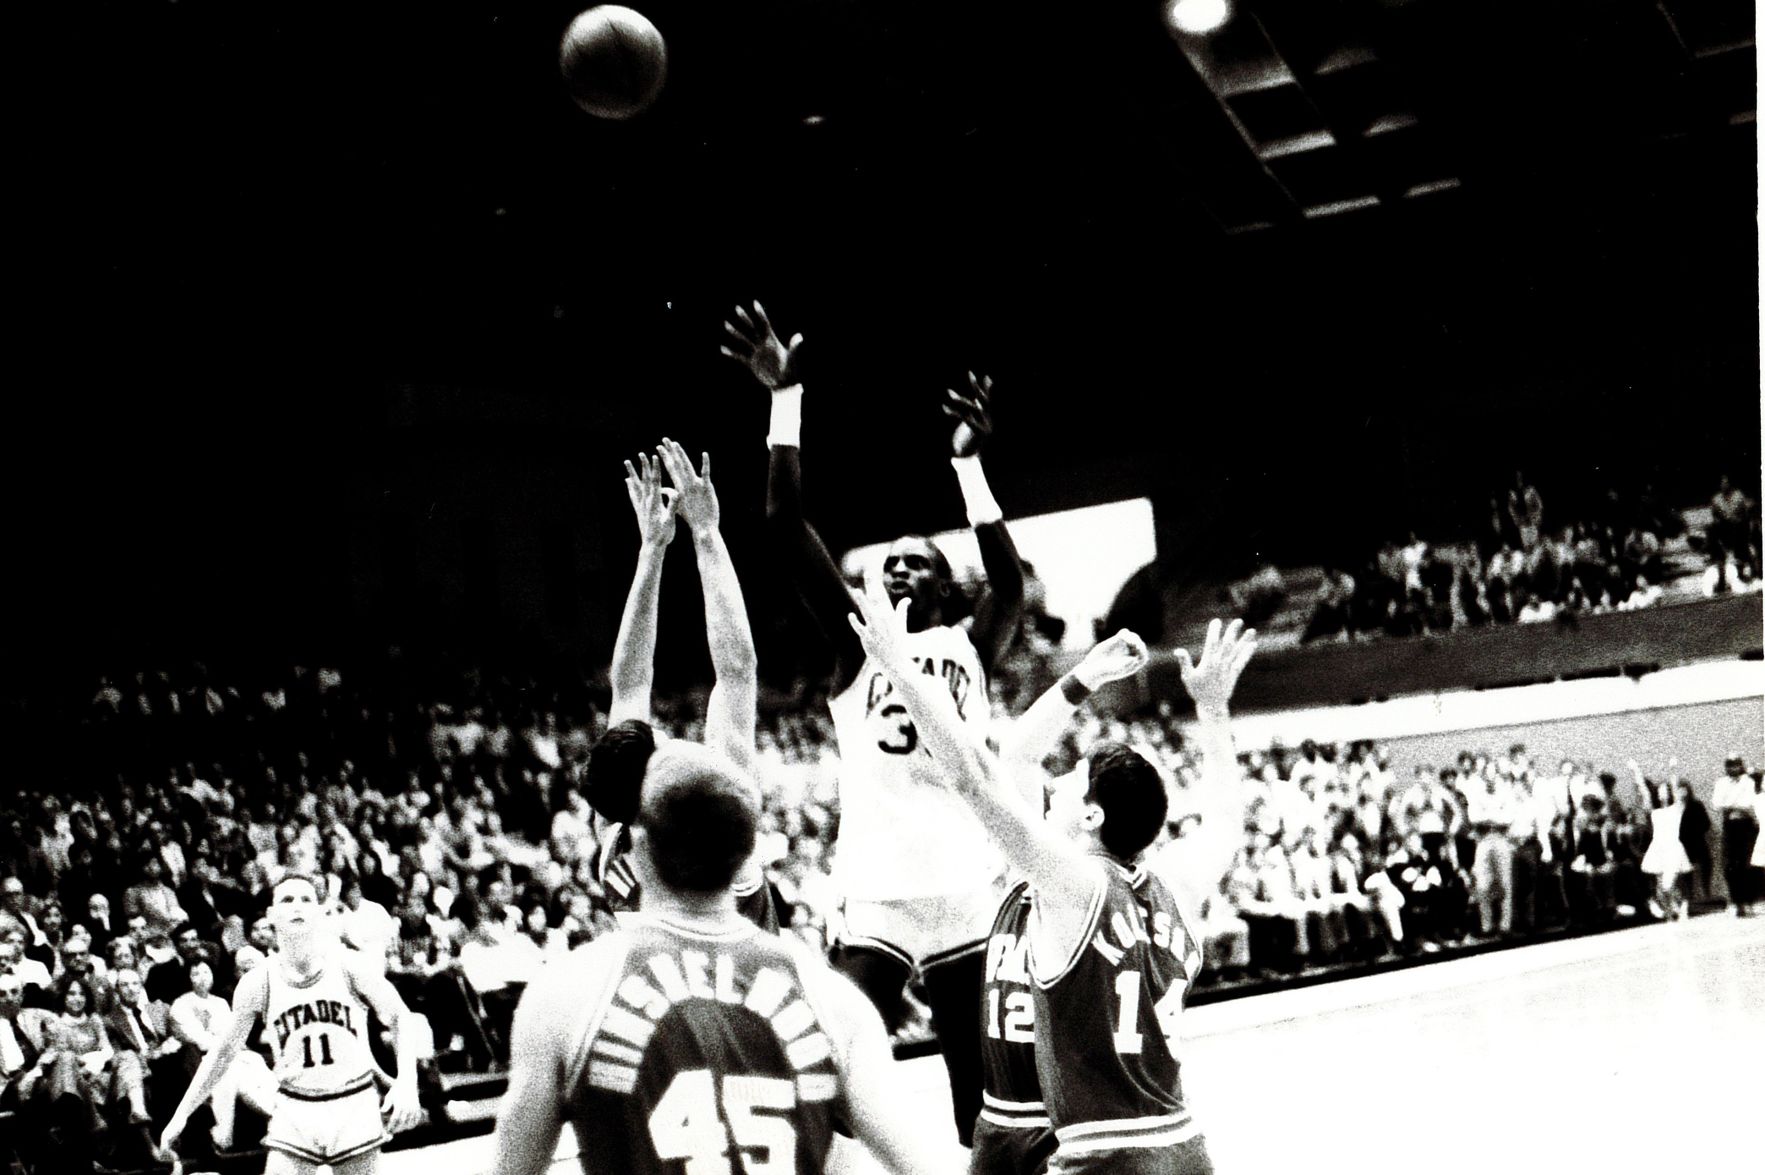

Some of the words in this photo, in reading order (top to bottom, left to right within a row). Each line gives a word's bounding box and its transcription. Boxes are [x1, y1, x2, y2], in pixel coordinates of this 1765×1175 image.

[302, 1032, 334, 1068] 11
[985, 987, 1036, 1043] 12
[1113, 970, 1188, 1061] 14
[648, 1067, 798, 1175] 45
